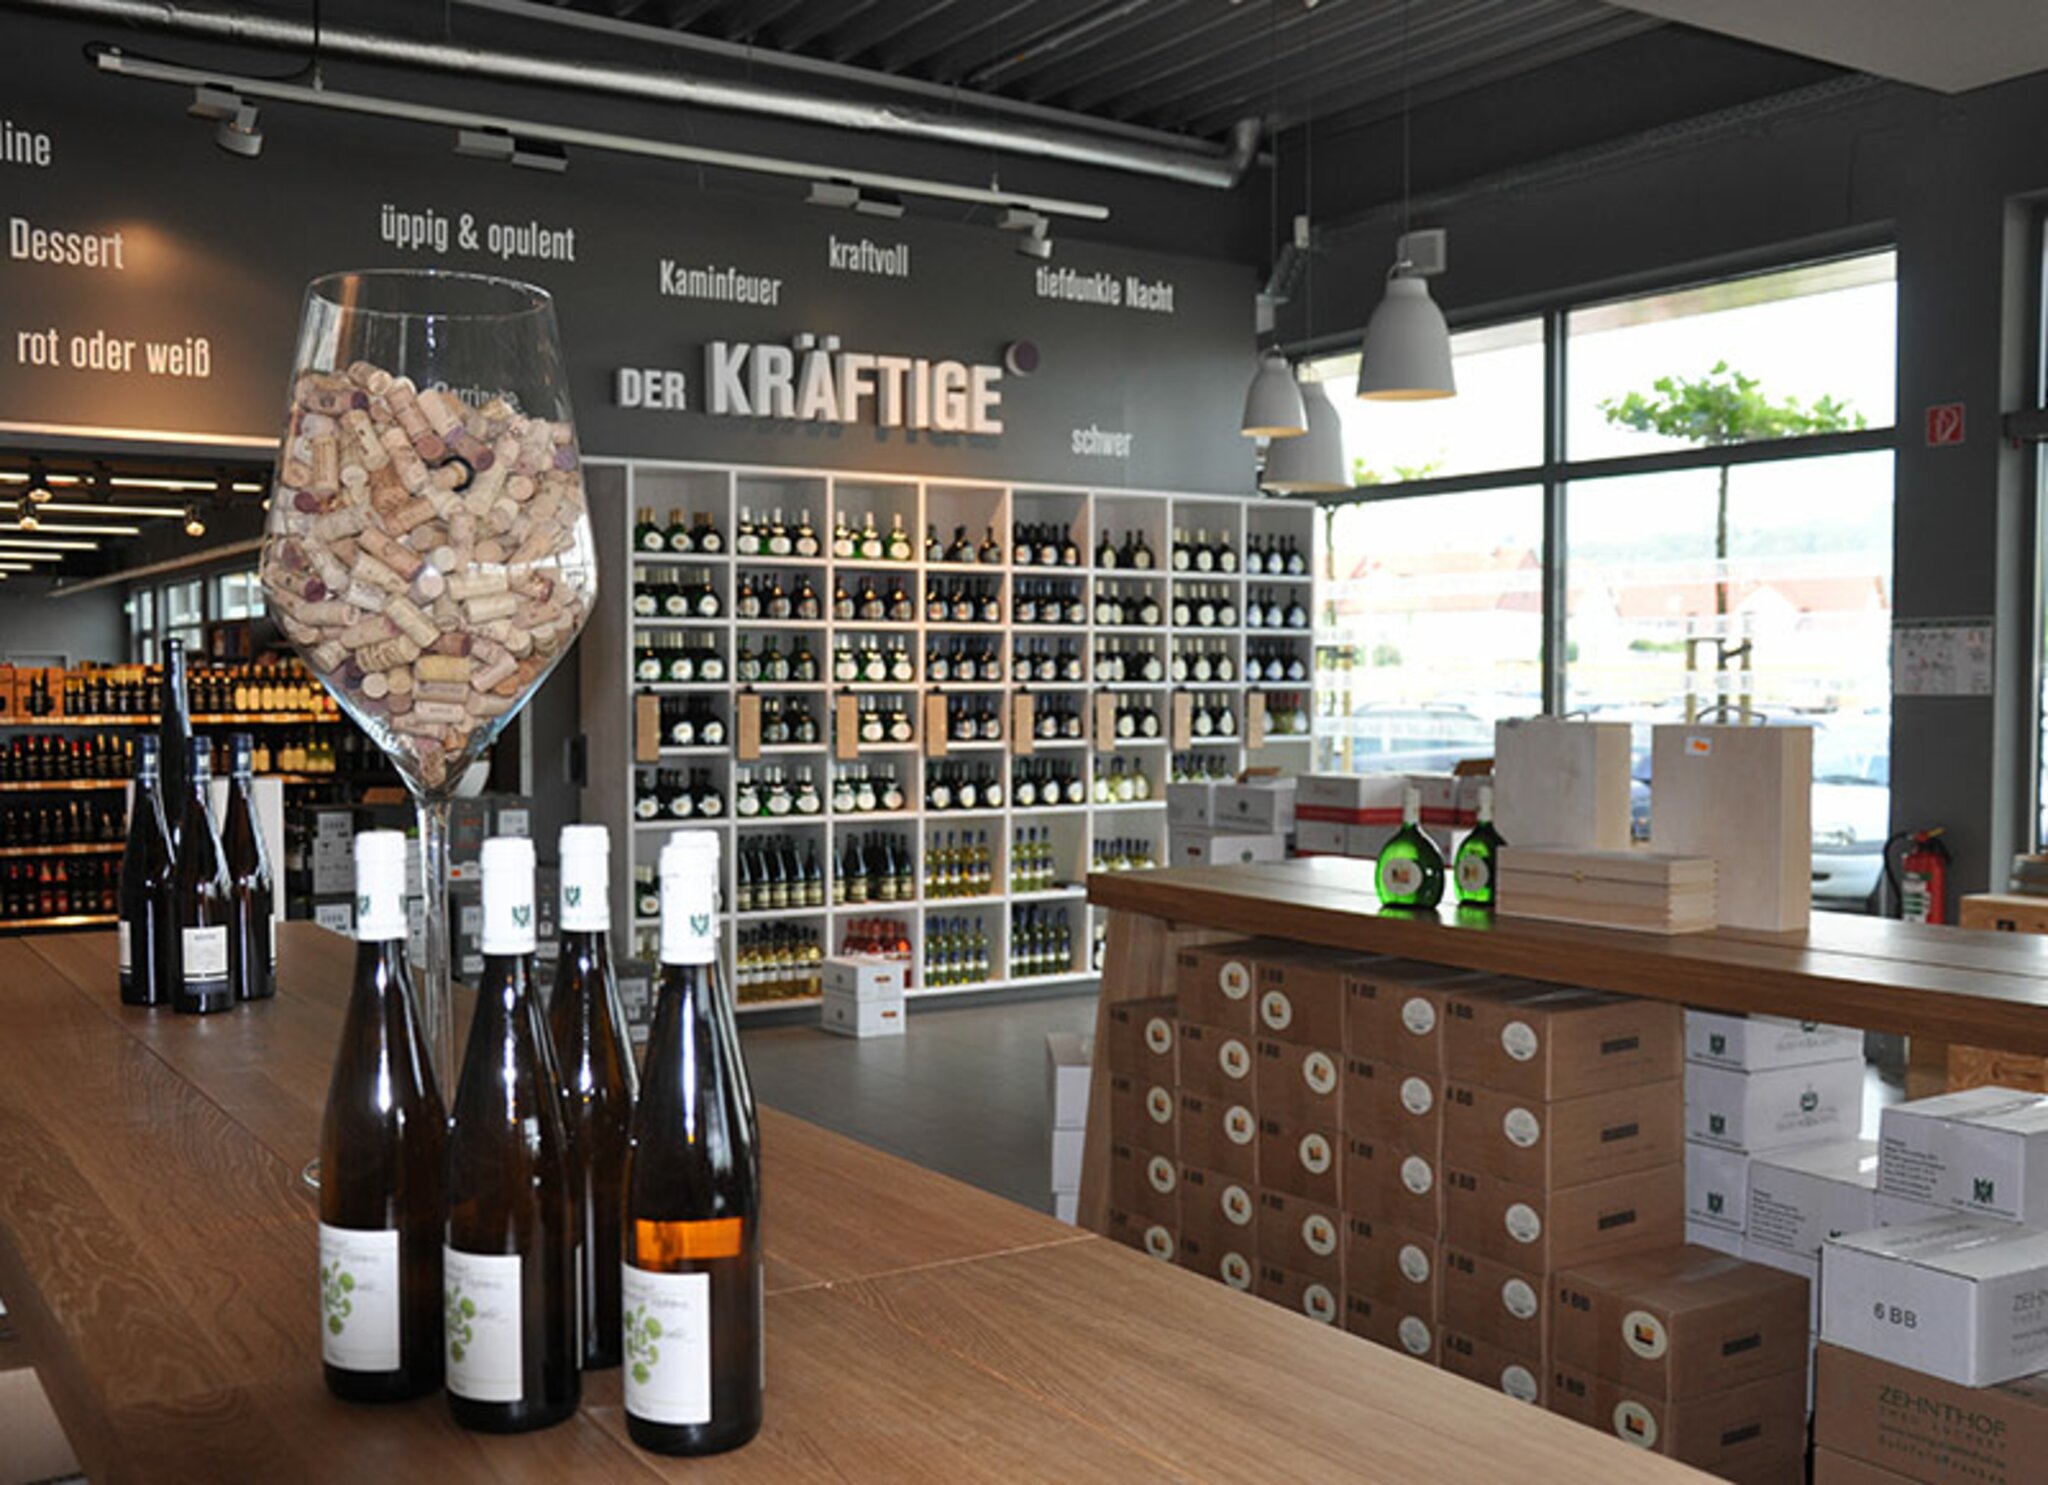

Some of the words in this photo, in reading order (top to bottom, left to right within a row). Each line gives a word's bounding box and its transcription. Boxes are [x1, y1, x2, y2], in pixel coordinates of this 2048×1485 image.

[10, 217, 124, 271] Dessert
[380, 203, 448, 253] üppig
[457, 212, 480, 250] &
[488, 221, 575, 262] opulent
[828, 235, 909, 277] kraftvoll
[660, 259, 783, 306] Kaminfeuer
[1126, 276, 1174, 313] Nacht
[17, 328, 60, 367] rot
[70, 329, 136, 373] oder
[145, 336, 211, 378] weiß
[617, 367, 687, 411] DER
[706, 332, 1003, 435] KRÄFTIGE
[1070, 424, 1133, 458] schwer
[1873, 1302, 1885, 1320] 6
[1889, 1305, 1918, 1329] BB
[1879, 1384, 2007, 1438] ZEHNTHOF
